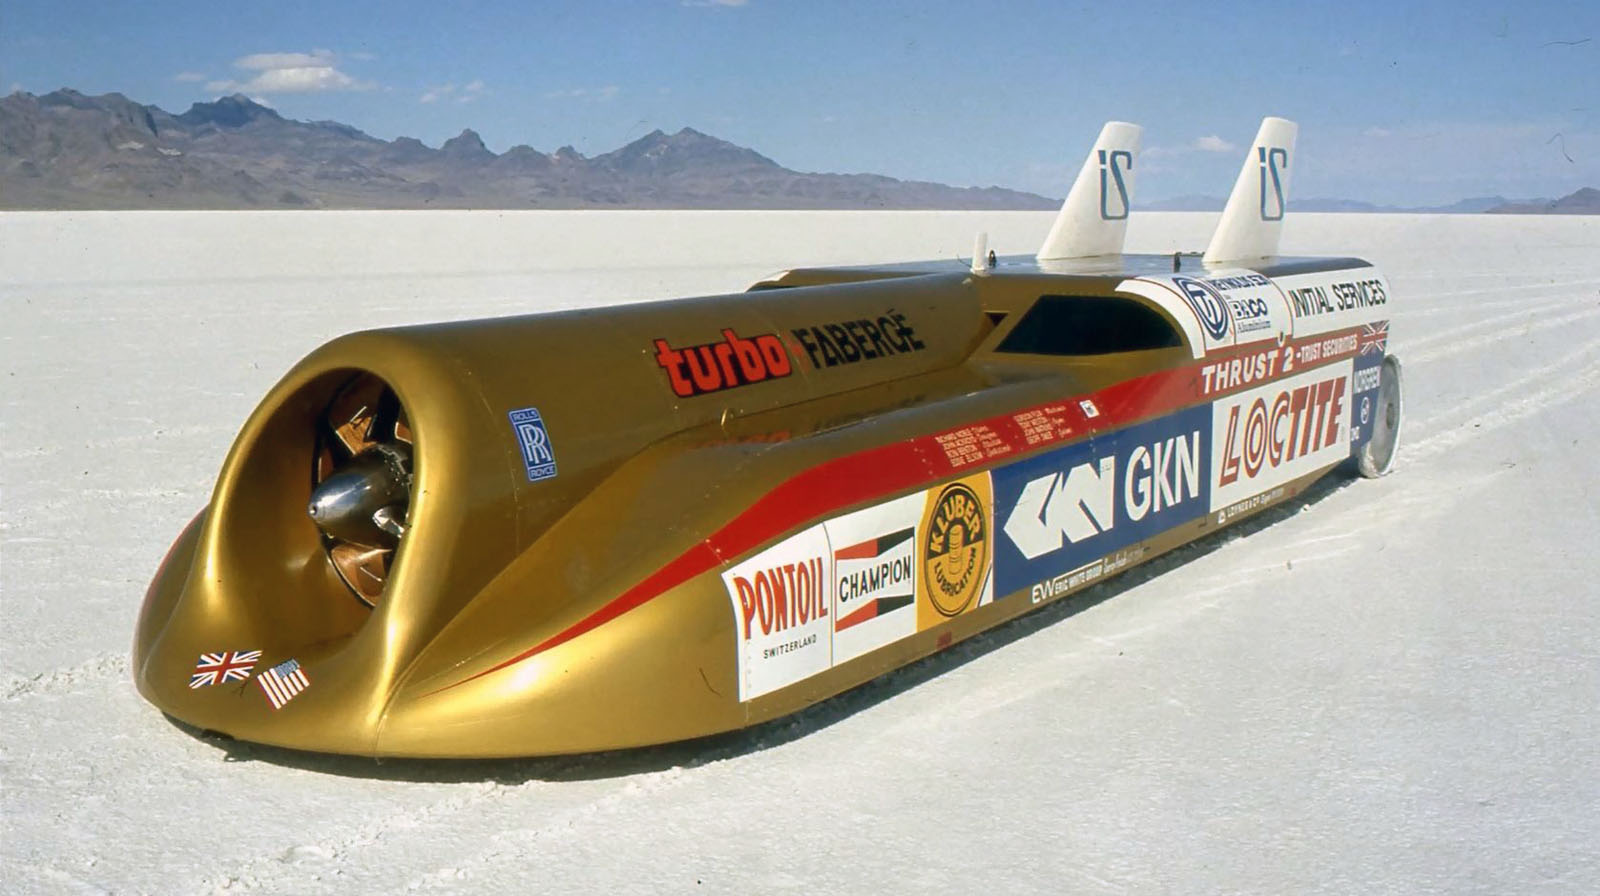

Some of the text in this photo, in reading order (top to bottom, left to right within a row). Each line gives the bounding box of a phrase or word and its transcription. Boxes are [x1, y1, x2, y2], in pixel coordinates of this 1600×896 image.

[1229, 298, 1268, 320] BACO
[1288, 279, 1386, 318] INITIAL SERVICES
[653, 327, 793, 398] turbo
[1202, 346, 1294, 393] THRUST 2
[1300, 334, 1358, 363] TRUST SECURITIES
[512, 411, 539, 421] ROLLS
[1219, 376, 1347, 488] LOCTITE
[530, 466, 554, 478] ROYCE
[1124, 431, 1200, 521] GKN
[839, 555, 911, 602] CHAMPION
[934, 547, 976, 596] LUBRICATION
[733, 557, 828, 640] PONTOIL
[763, 634, 817, 659] SWITZERLAND
